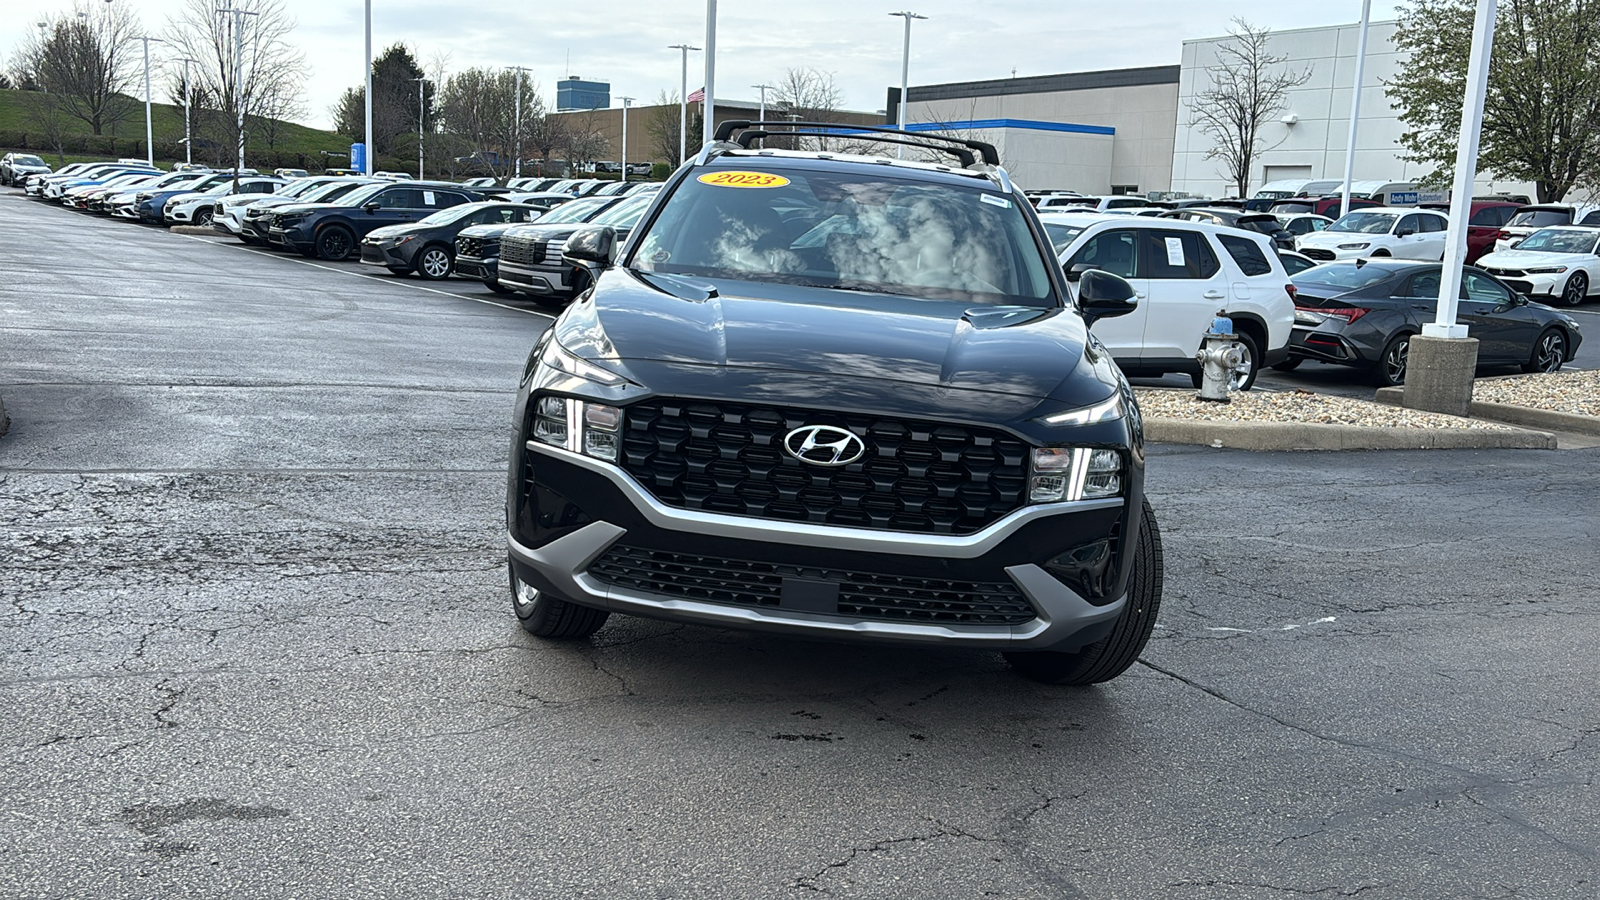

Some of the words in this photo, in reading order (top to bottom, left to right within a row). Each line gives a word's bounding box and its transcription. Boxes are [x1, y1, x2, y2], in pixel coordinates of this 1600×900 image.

[711, 173, 777, 185] 2023
[1391, 194, 1404, 204] Andy
[1404, 193, 1417, 202] Mohr
[1417, 193, 1442, 202] Automotive
